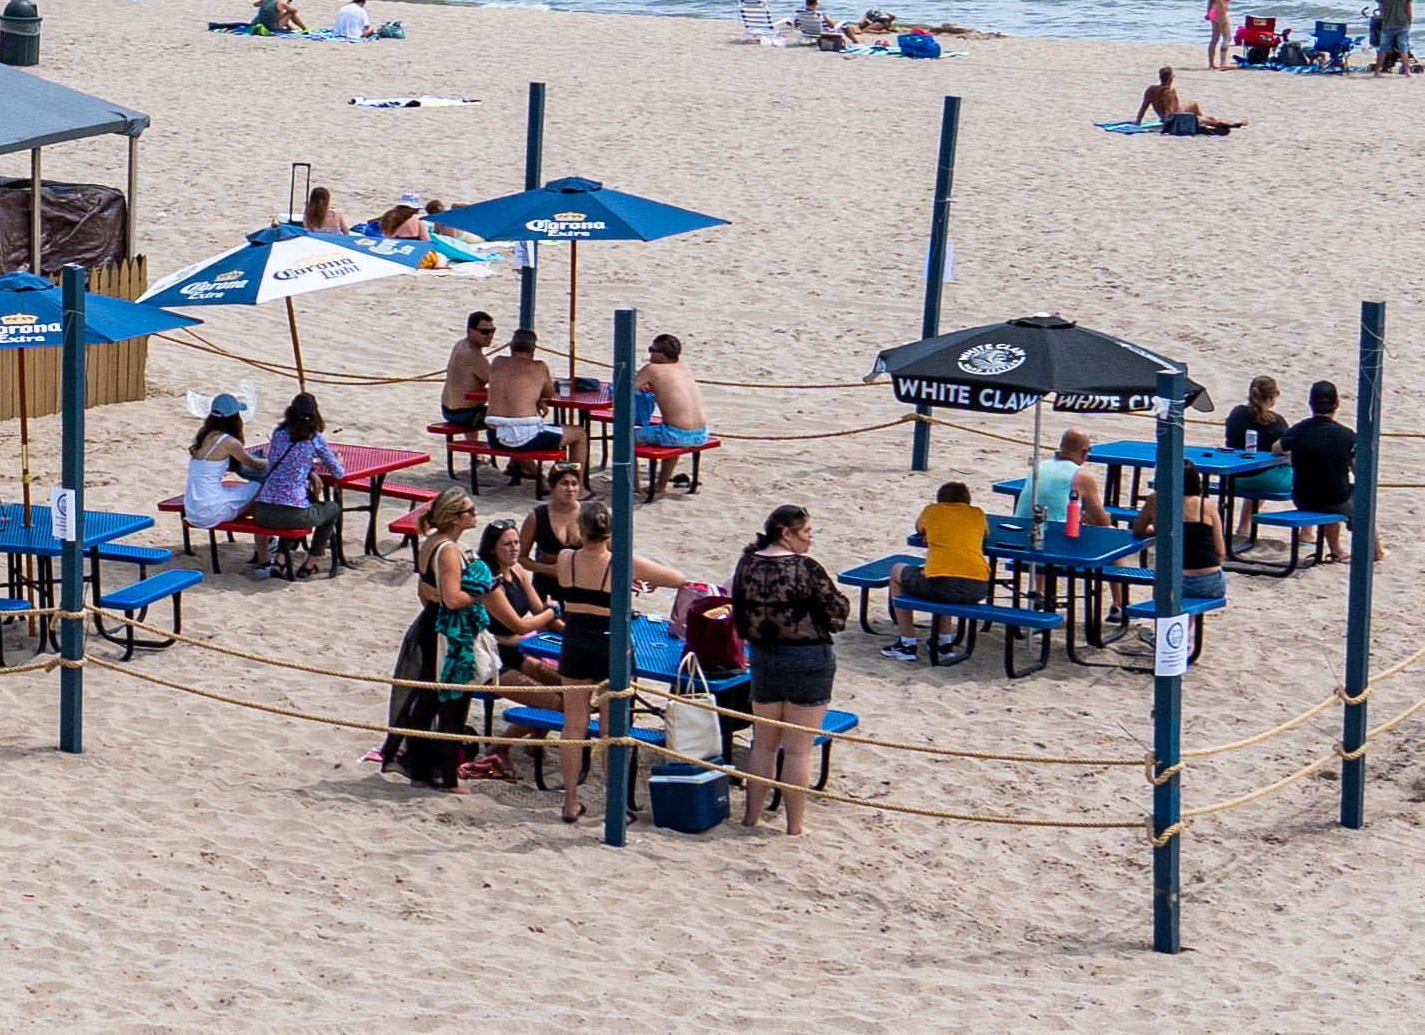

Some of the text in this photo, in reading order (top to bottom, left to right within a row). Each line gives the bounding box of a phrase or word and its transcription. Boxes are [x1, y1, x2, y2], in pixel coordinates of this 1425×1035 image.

[525, 218, 607, 233] Corona
[548, 229, 591, 237] Extra
[272, 257, 355, 281] Corona
[320, 265, 361, 280] Light
[180, 279, 249, 295] Corona
[187, 291, 225, 300] Extra
[898, 377, 1043, 411] WHITE CLAW
[1056, 394, 1121, 411] WHITE
